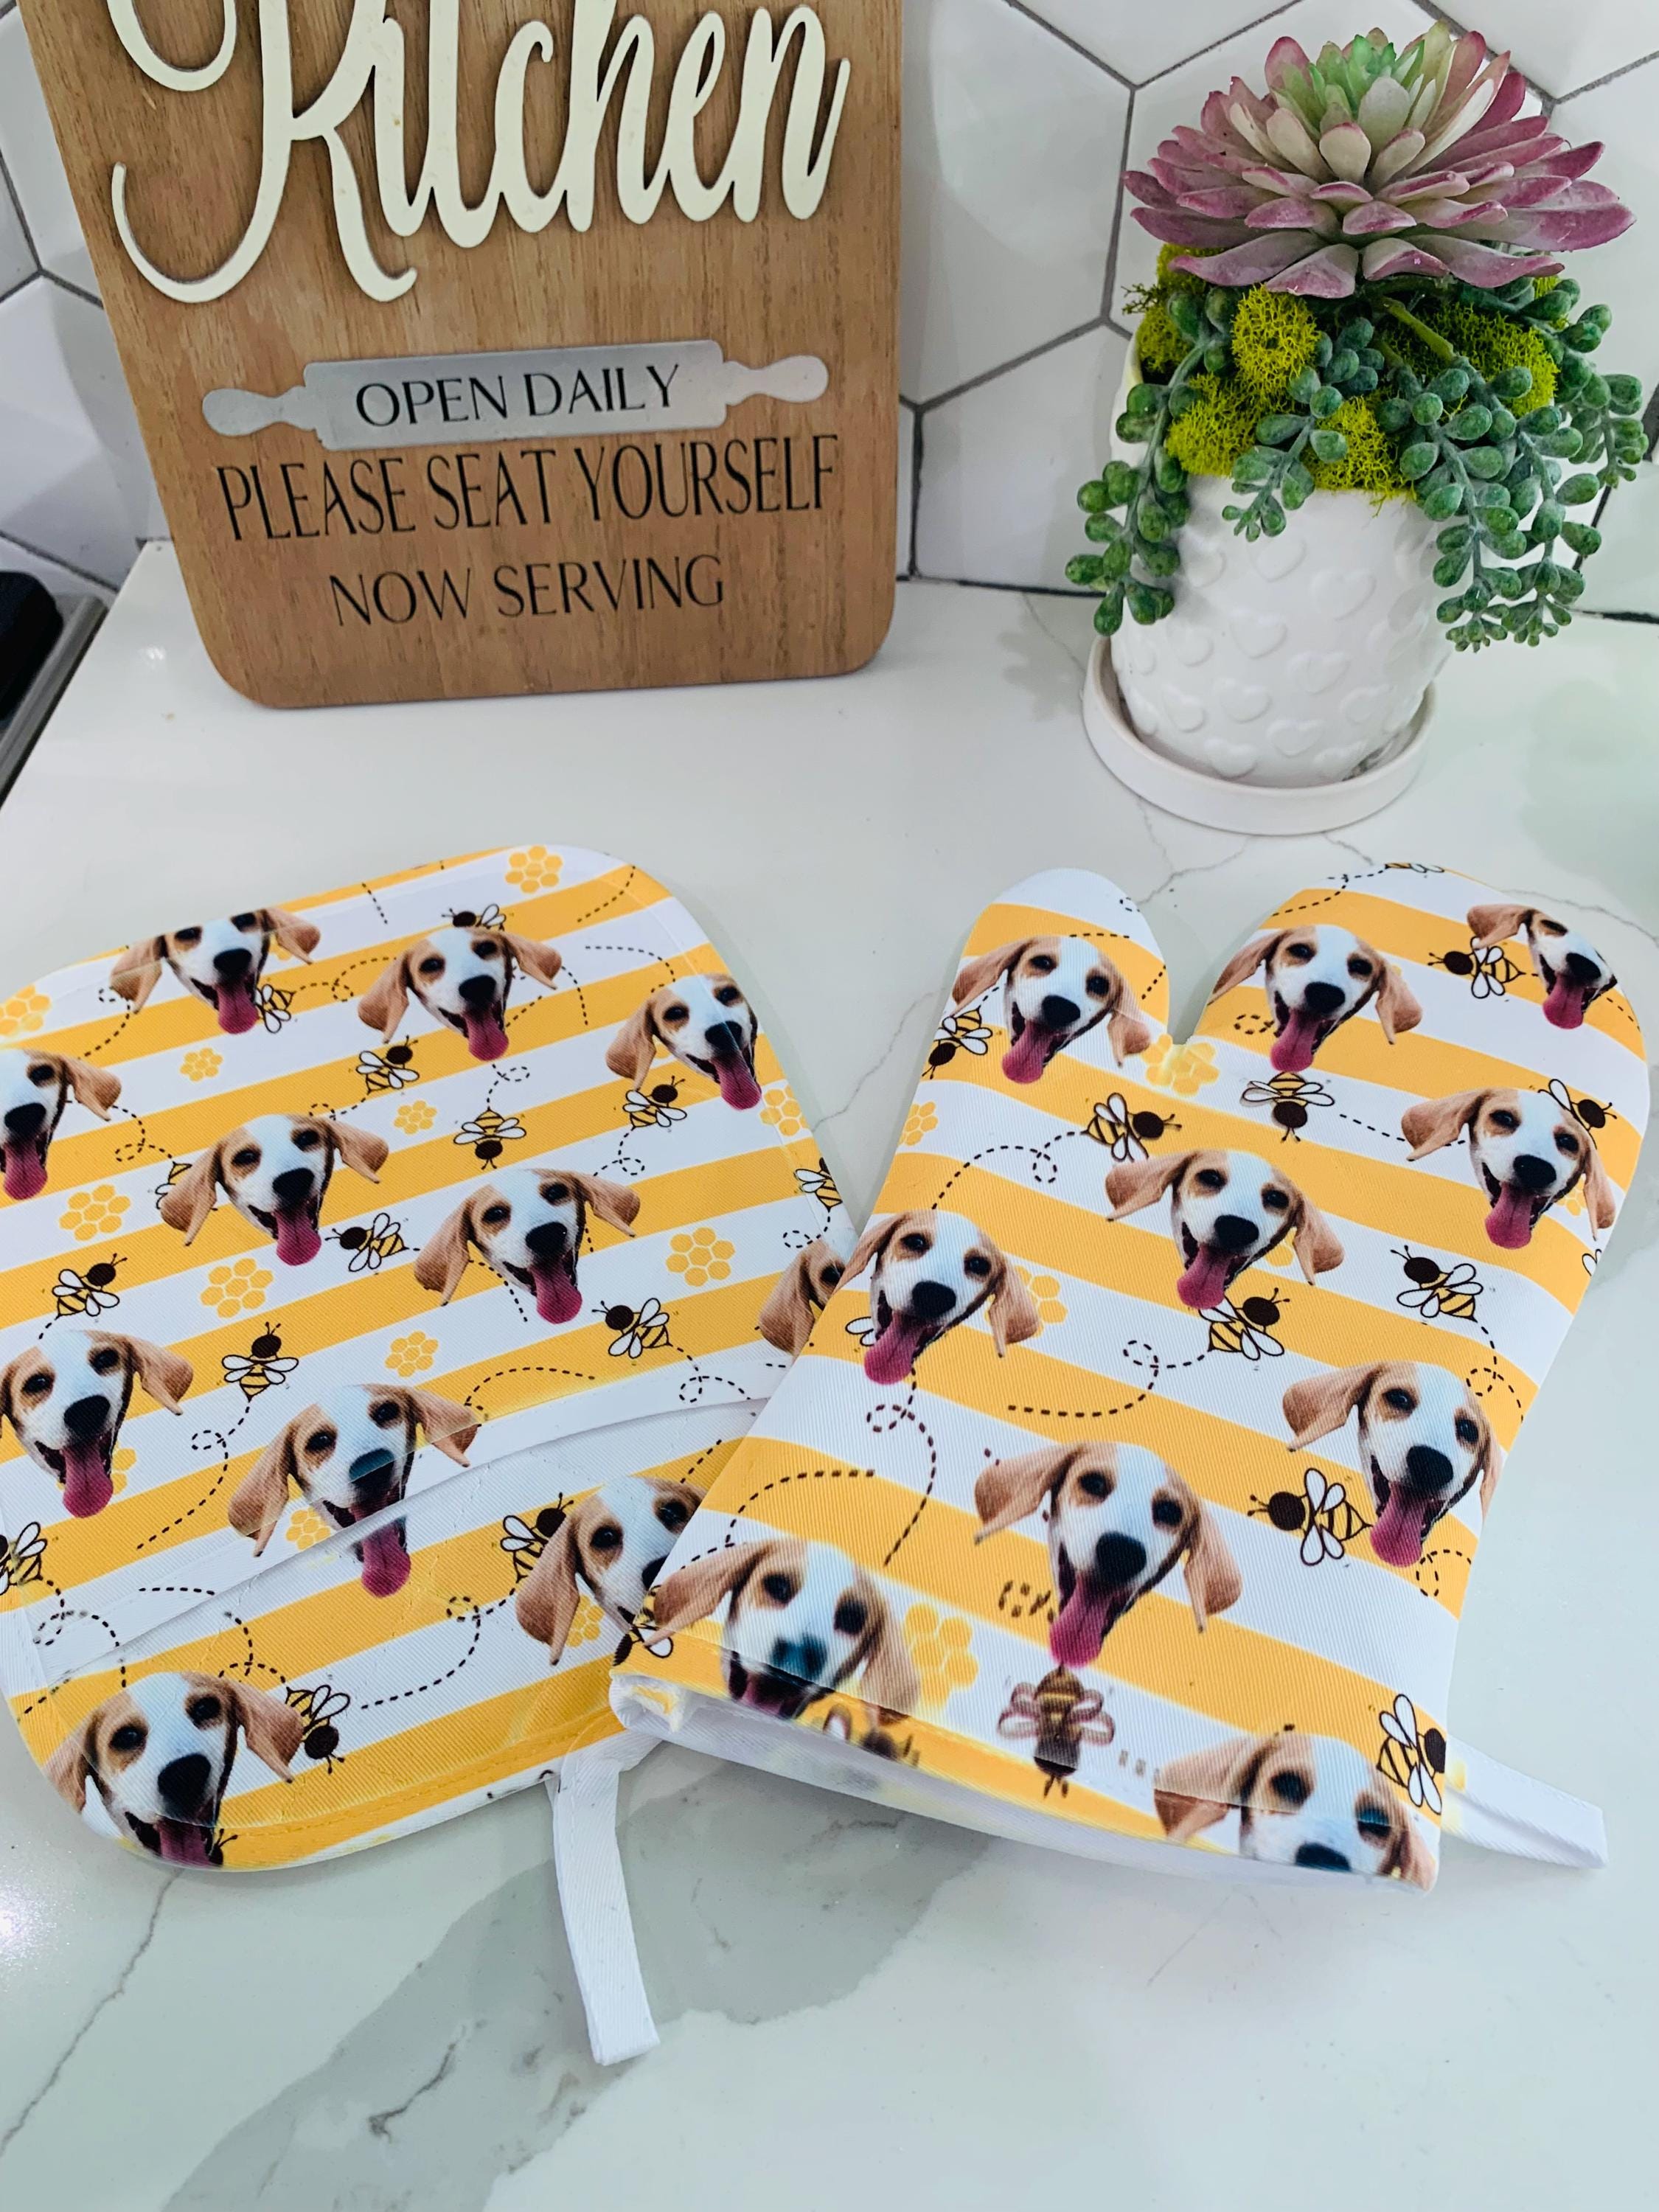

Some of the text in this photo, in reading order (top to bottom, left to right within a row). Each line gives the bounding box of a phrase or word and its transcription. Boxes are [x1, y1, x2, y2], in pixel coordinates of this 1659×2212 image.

[356, 364, 679, 427] OPEN DAILY
[216, 434, 838, 541] PLEASE SEAT YOURSELF
[329, 554, 724, 627] NOW SERVING
